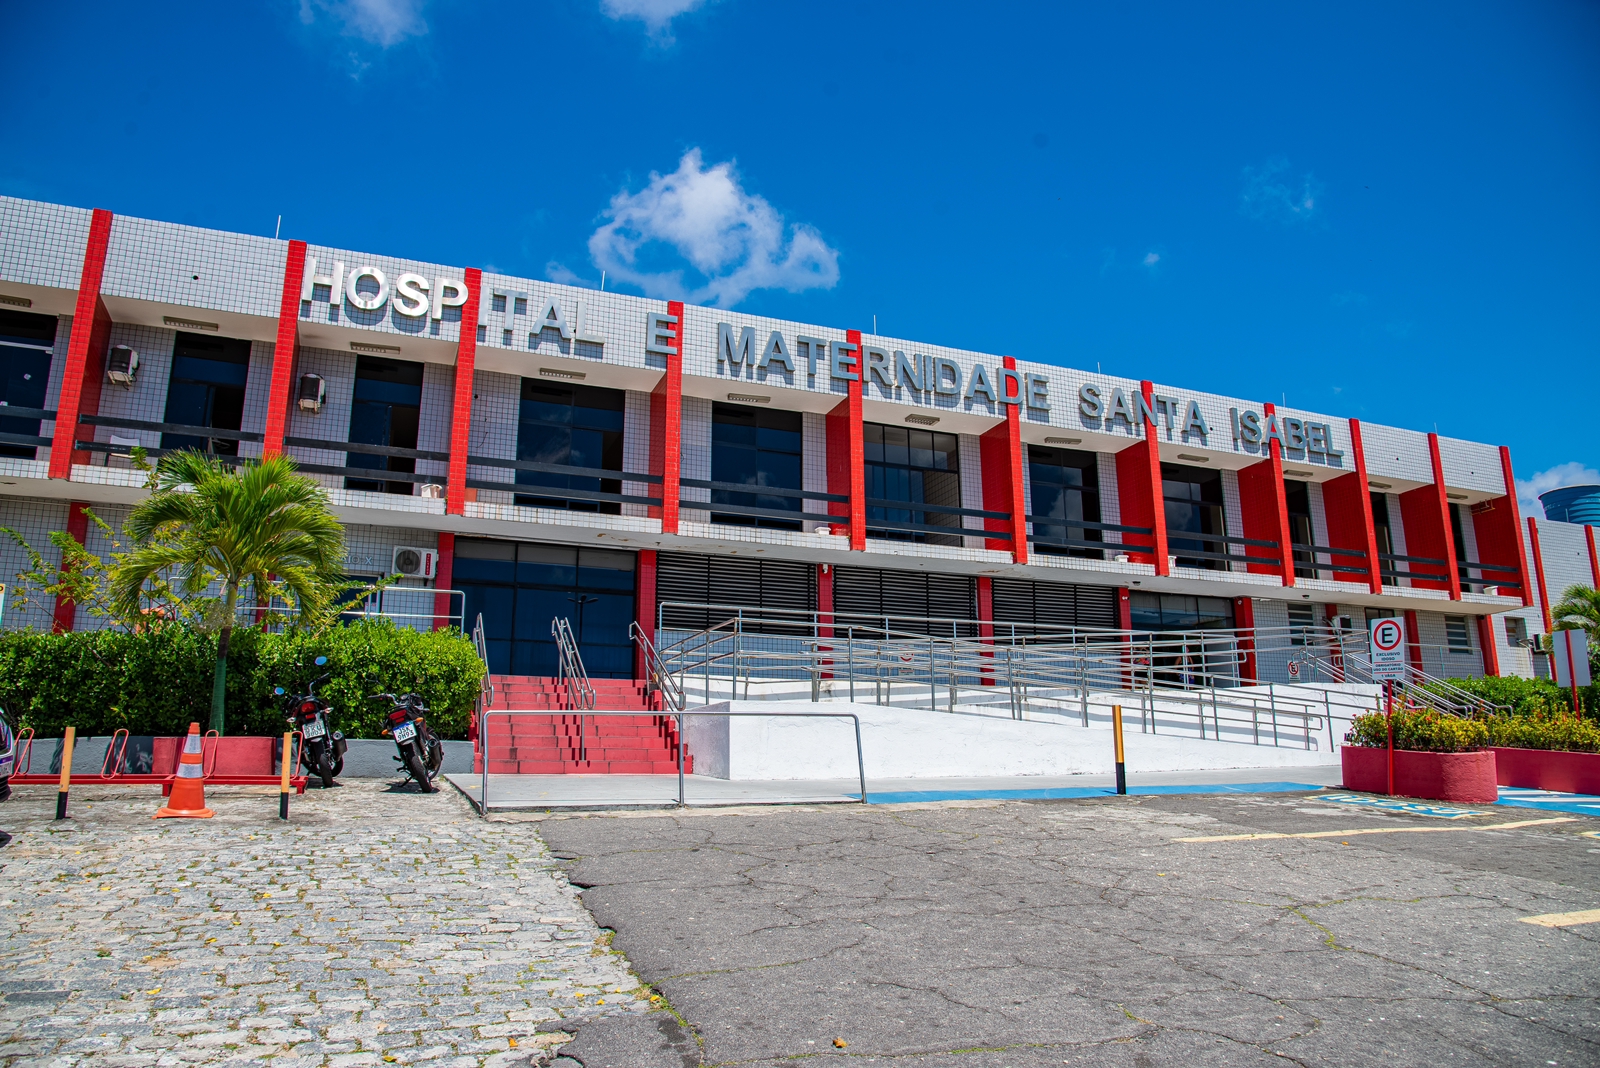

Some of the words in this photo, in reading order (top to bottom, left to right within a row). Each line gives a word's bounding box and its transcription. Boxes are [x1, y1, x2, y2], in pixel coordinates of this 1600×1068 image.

[301, 258, 605, 343] HOSPITAL
[646, 311, 678, 355] E
[717, 321, 1052, 411] MATERNIDADE
[1078, 382, 1210, 435] SANTA
[1229, 407, 1344, 457] ISABEL
[1381, 627, 1394, 644] E
